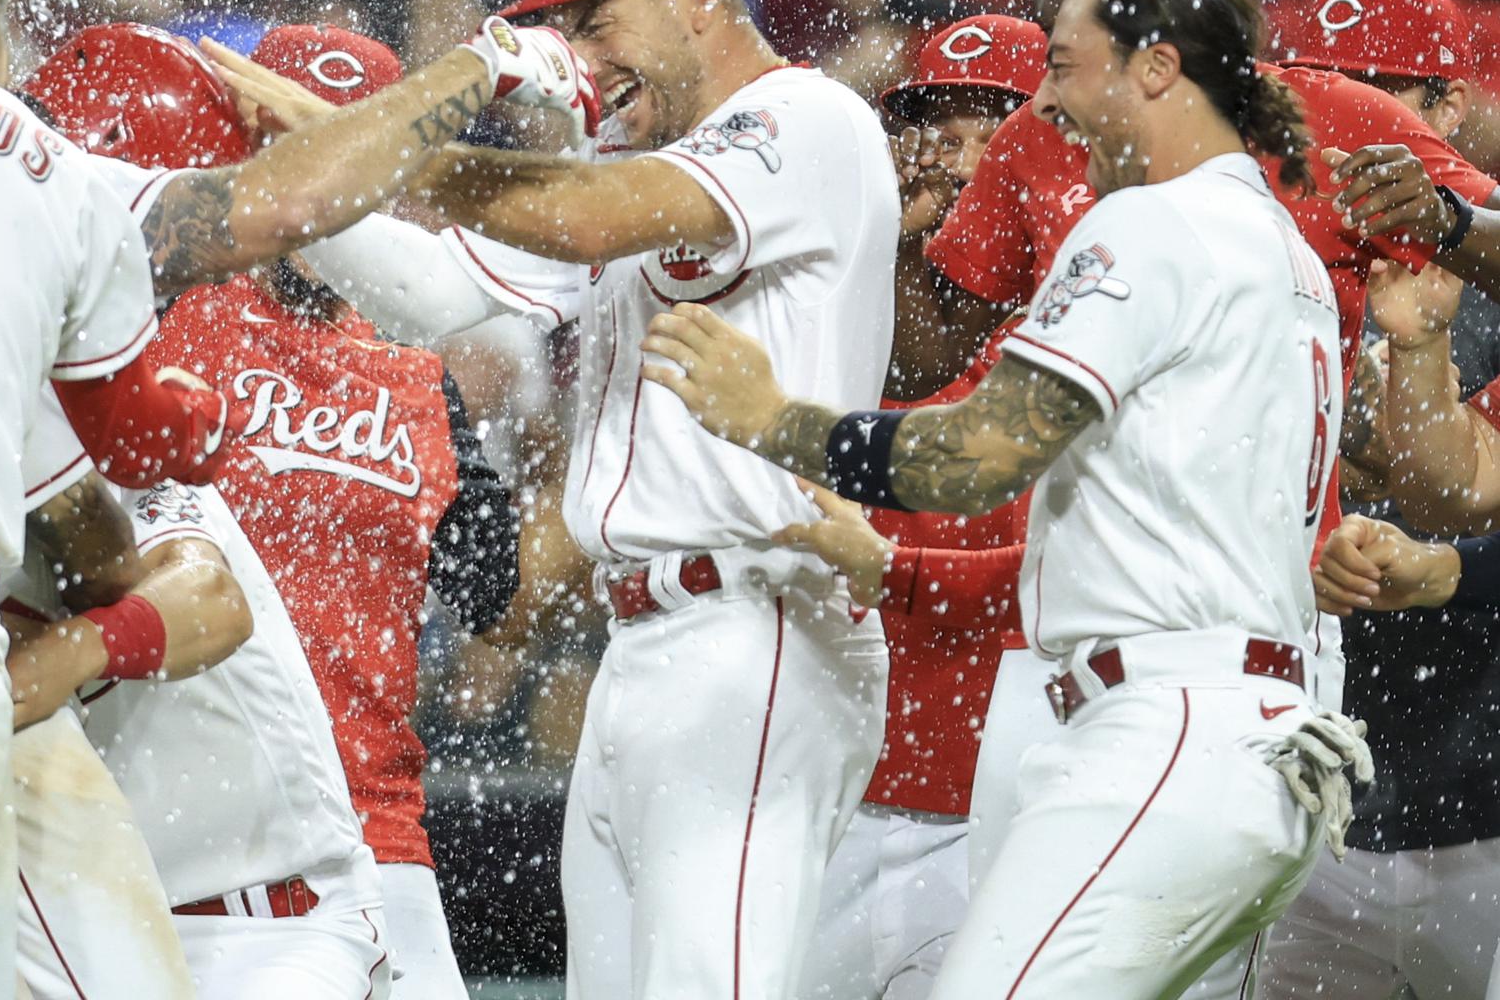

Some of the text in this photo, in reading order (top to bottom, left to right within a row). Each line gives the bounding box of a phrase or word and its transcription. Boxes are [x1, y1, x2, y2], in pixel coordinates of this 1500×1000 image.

[938, 25, 994, 61] C
[306, 49, 366, 89] C
[232, 368, 422, 498] Reds
